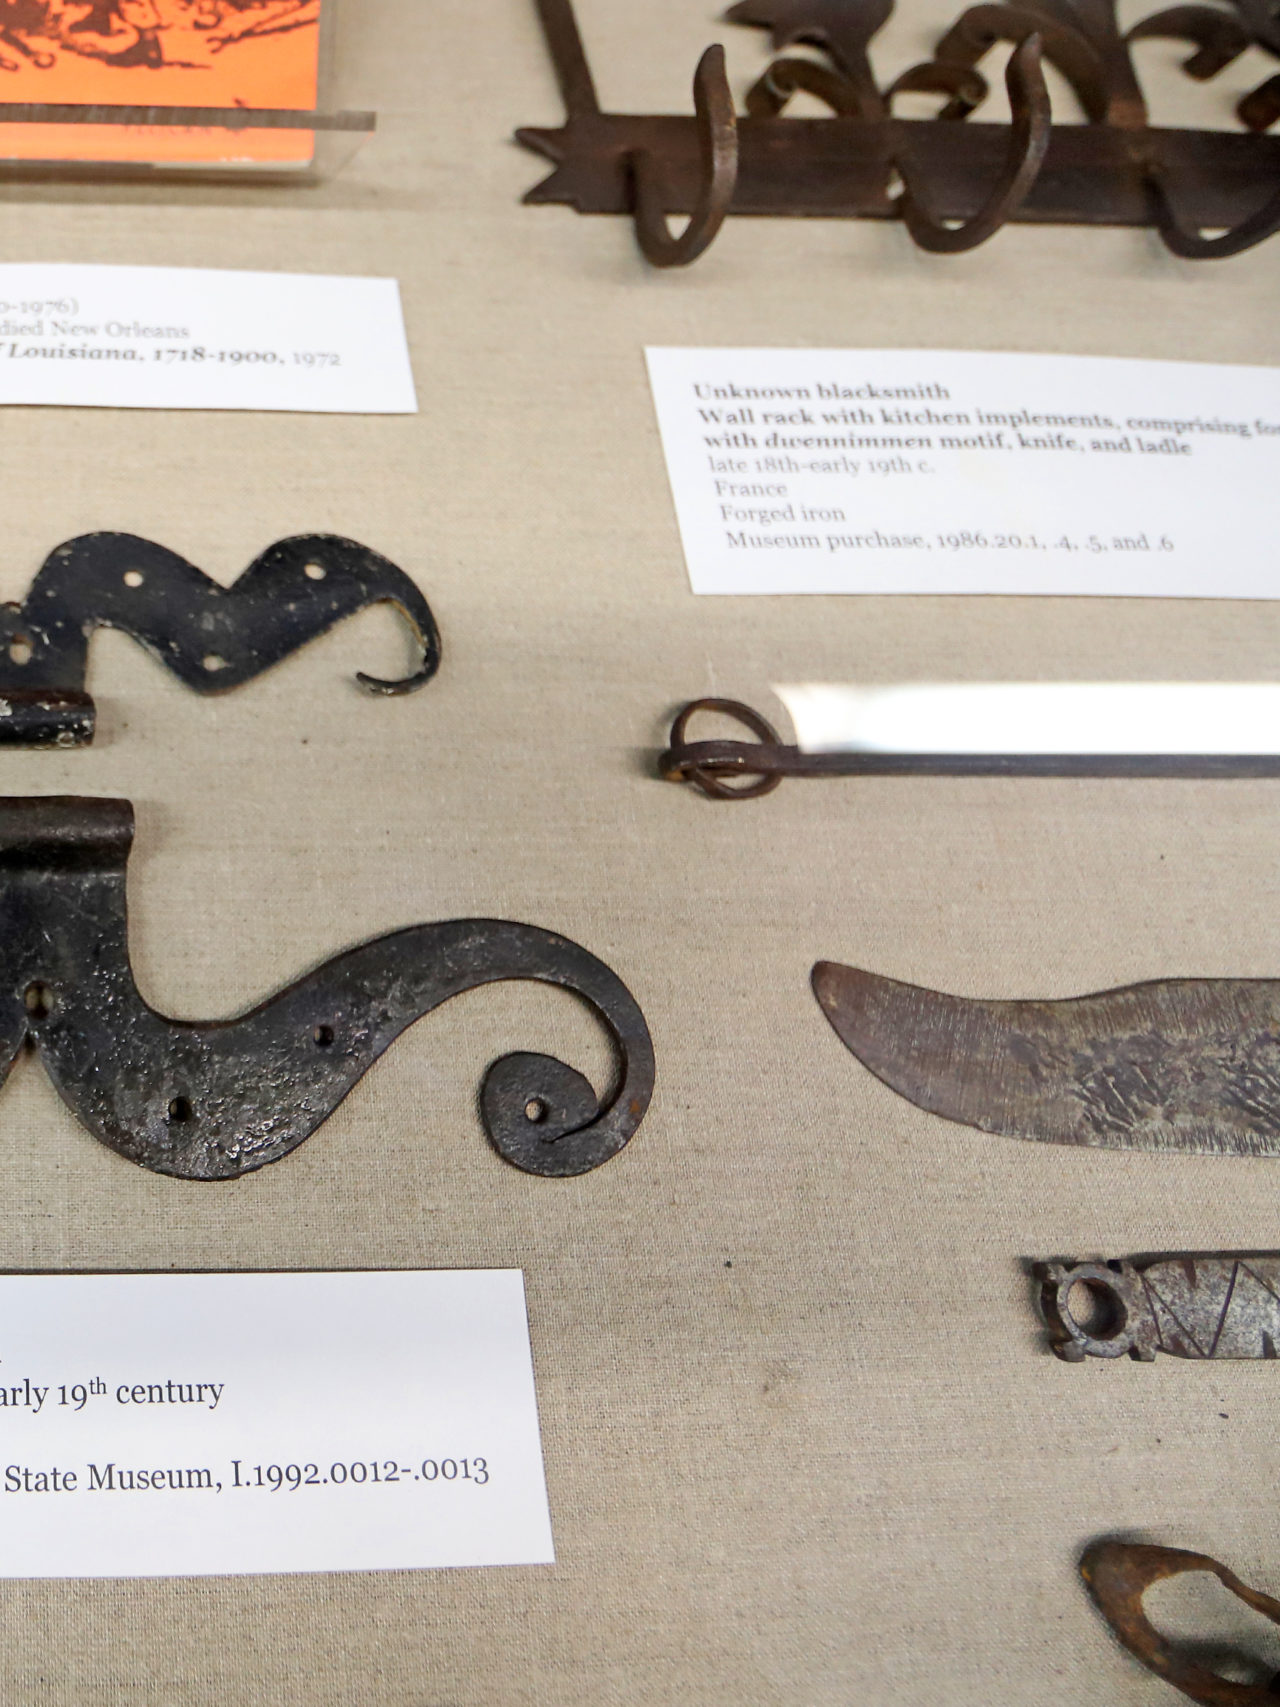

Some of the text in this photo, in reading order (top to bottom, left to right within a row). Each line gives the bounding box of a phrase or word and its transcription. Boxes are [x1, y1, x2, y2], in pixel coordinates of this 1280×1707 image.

[50, 320, 99, 336] New
[104, 320, 190, 339] Orleans
[8, 342, 145, 362] Louisiana,
[152, 346, 285, 365] 1718-1900,
[293, 351, 341, 368] 1972
[693, 382, 951, 400] Unknown blacksmith
[696, 408, 756, 425] Wall
[761, 408, 815, 425] rack
[821, 408, 874, 425] with
[878, 408, 972, 425] kitchen
[976, 408, 1121, 432] implements,
[1125, 416, 1252, 439] comprising
[703, 430, 1193, 456] with dwennimmen motif, knife, and ladle
[707, 454, 936, 477] late 18th-early 19th c.
[713, 478, 789, 497] France
[719, 503, 847, 527] Forged iron
[725, 530, 821, 549] Museum
[825, 530, 932, 553] purchase,
[1111, 533, 1151, 551] and
[57, 1376, 107, 1411] 19th
[115, 1380, 224, 1409] century
[4, 1465, 77, 1492] State
[86, 1464, 222, 1493] Museum,
[230, 1458, 490, 1492] I.1992.0012-.0013
